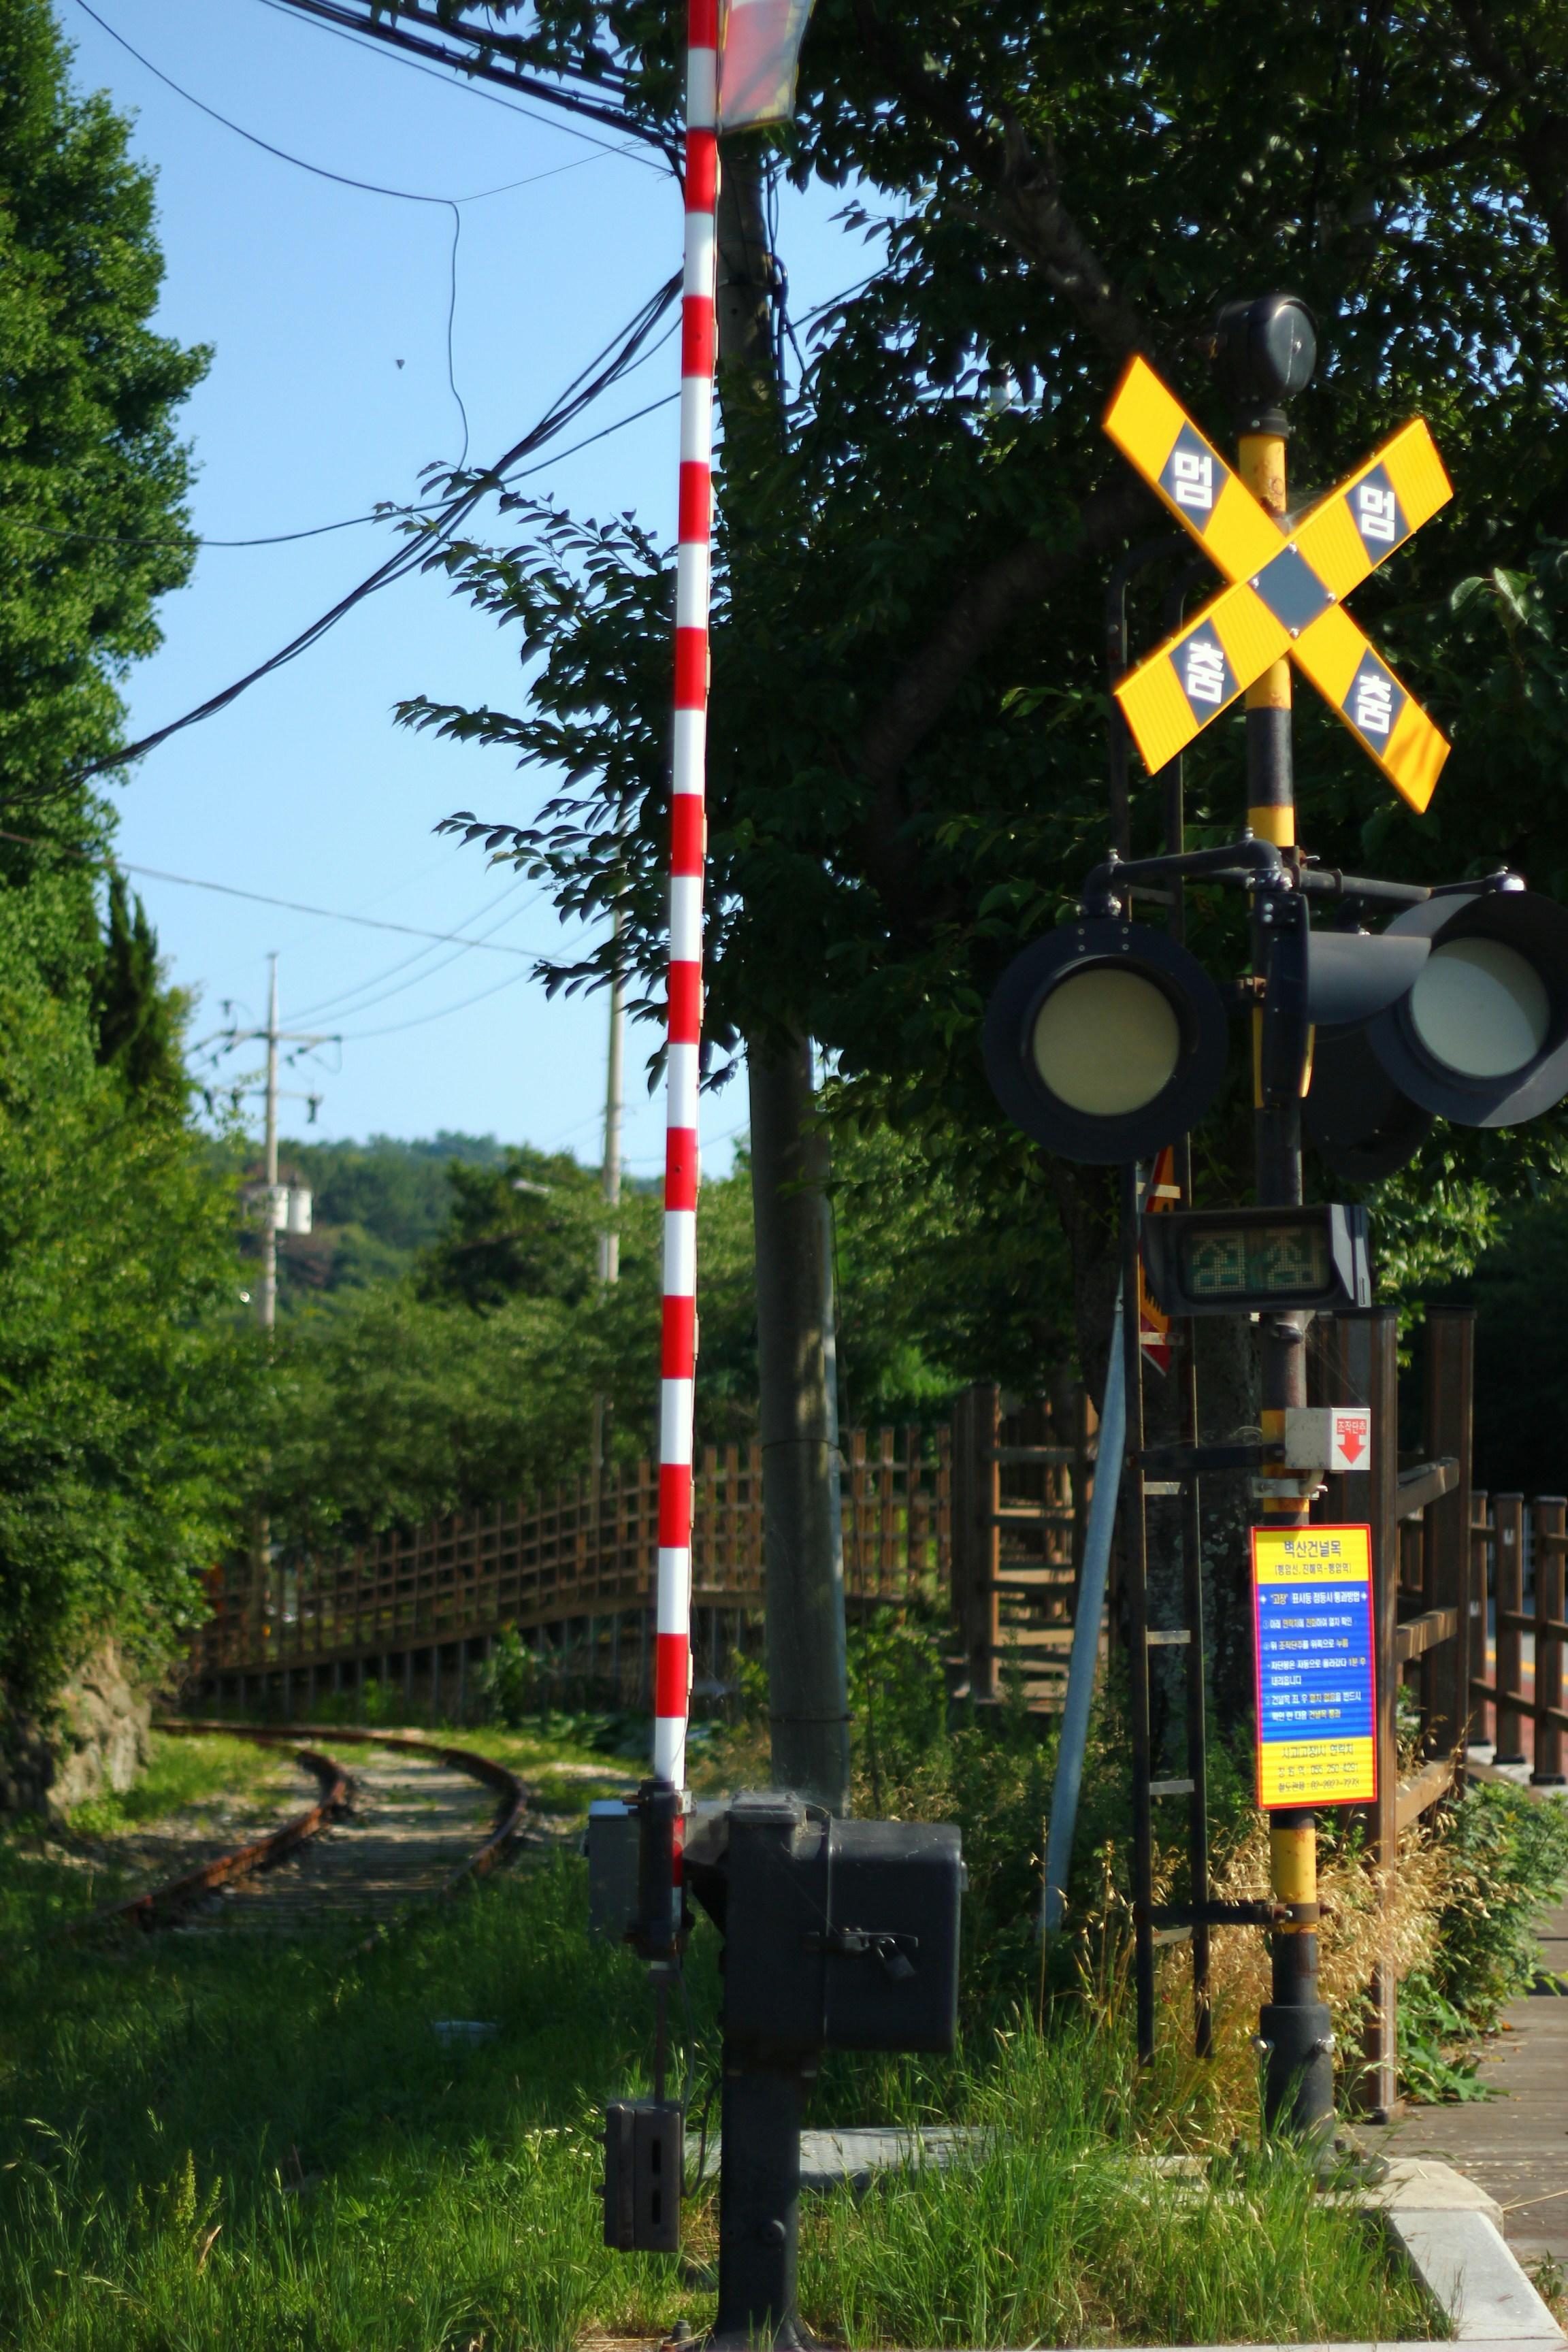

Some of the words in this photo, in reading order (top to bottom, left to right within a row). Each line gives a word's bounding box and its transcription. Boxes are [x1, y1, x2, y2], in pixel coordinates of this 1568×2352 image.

[1175, 451, 1212, 508] 멈
[1360, 485, 1395, 541] 멈
[1187, 642, 1224, 703] 춤
[1357, 674, 1392, 734] 춤
[1338, 1420, 1367, 1434] 조작단추
[1284, 1540, 1341, 1558] 벽산건널목
[1292, 1592, 1312, 1605] 표시등
[1313, 1592, 1333, 1603] 점등시
[1335, 1591, 1360, 1603] 통과방법
[1270, 1619, 1281, 1629] 아래
[1284, 1618, 1305, 1629] 연락처에
[1307, 1618, 1328, 1628] 전화하여
[1329, 1617, 1340, 1627] 열차
[1341, 1616, 1352, 1627] 확인
[1271, 1641, 1277, 1651] 위
[1311, 1639, 1335, 1650] 위쪽으로
[1337, 1638, 1349, 1648] 누름
[1271, 1660, 1296, 1671] 차단봉은
[1297, 1659, 1321, 1669] 자동으로
[1323, 1658, 1347, 1669] 올라갔다
[1349, 1657, 1358, 1667] 1분
[1360, 1657, 1367, 1666] 후
[1271, 1675, 1302, 1686] 내려옵니다
[1272, 1695, 1290, 1705] 건널목
[1301, 1694, 1308, 1703] 우
[1343, 1691, 1361, 1702] 반드시
[1272, 1712, 1285, 1722] 확인
[1286, 1712, 1293, 1721] 한
[1295, 1710, 1307, 1720] 다음
[1309, 1710, 1327, 1720] 건널목
[1329, 1709, 1341, 1718] 통과
[1330, 1743, 1353, 1757] 연락처
